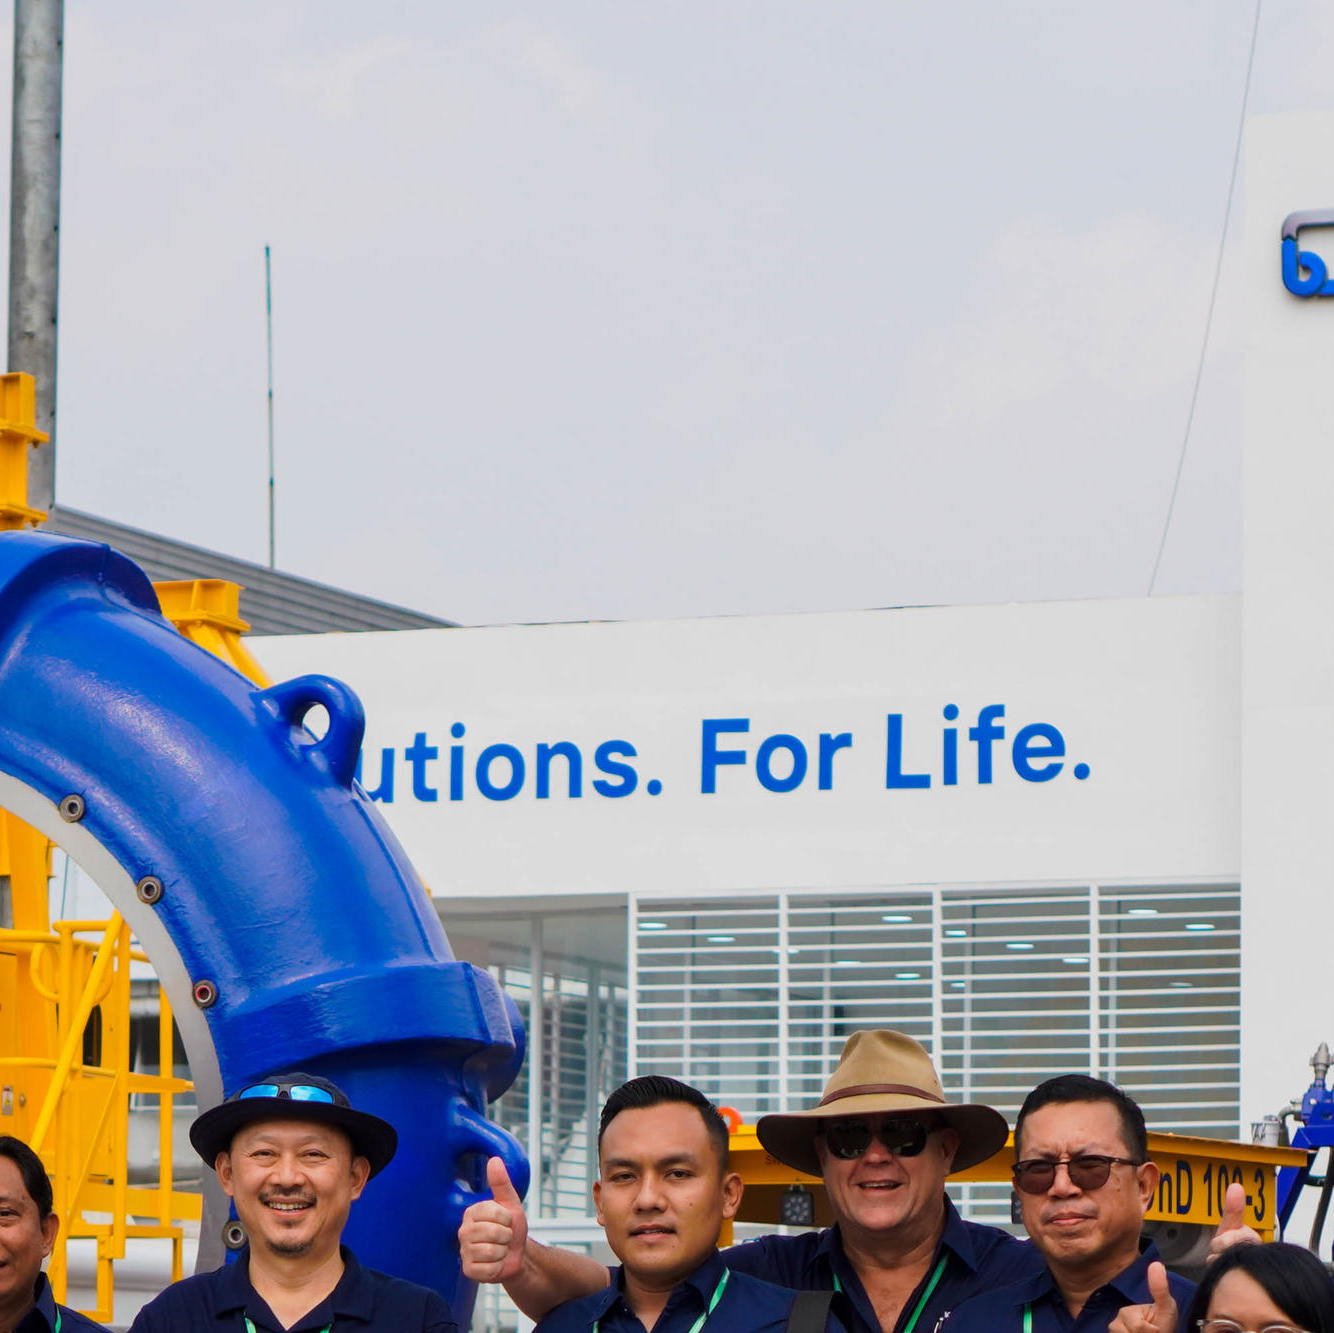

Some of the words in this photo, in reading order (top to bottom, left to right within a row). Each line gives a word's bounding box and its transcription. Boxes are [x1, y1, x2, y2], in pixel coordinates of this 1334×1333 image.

[700, 717, 854, 796] For
[884, 703, 1092, 791] Life.
[1147, 1160, 1193, 1215] nD
